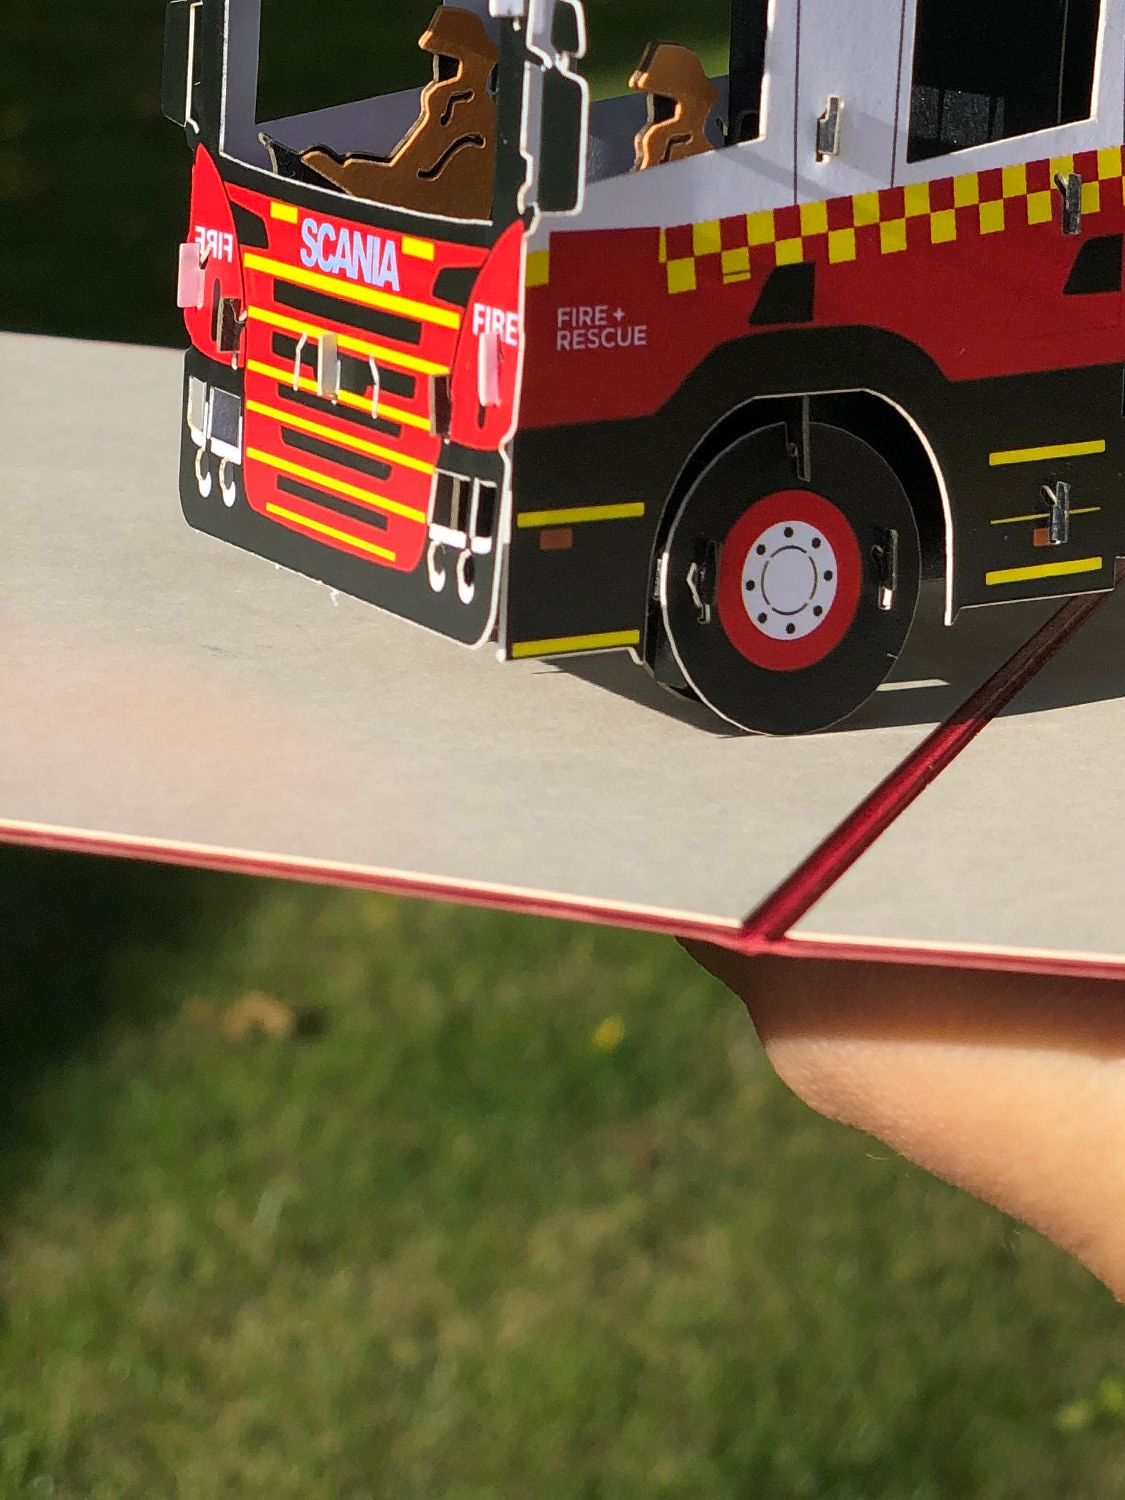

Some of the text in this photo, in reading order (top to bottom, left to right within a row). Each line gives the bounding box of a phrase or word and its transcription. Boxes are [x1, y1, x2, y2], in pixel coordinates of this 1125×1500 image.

[301, 218, 400, 292] SCANIA
[473, 302, 519, 347] FIRE
[557, 305, 608, 328] FIRE
[557, 325, 647, 351] RESCUE
